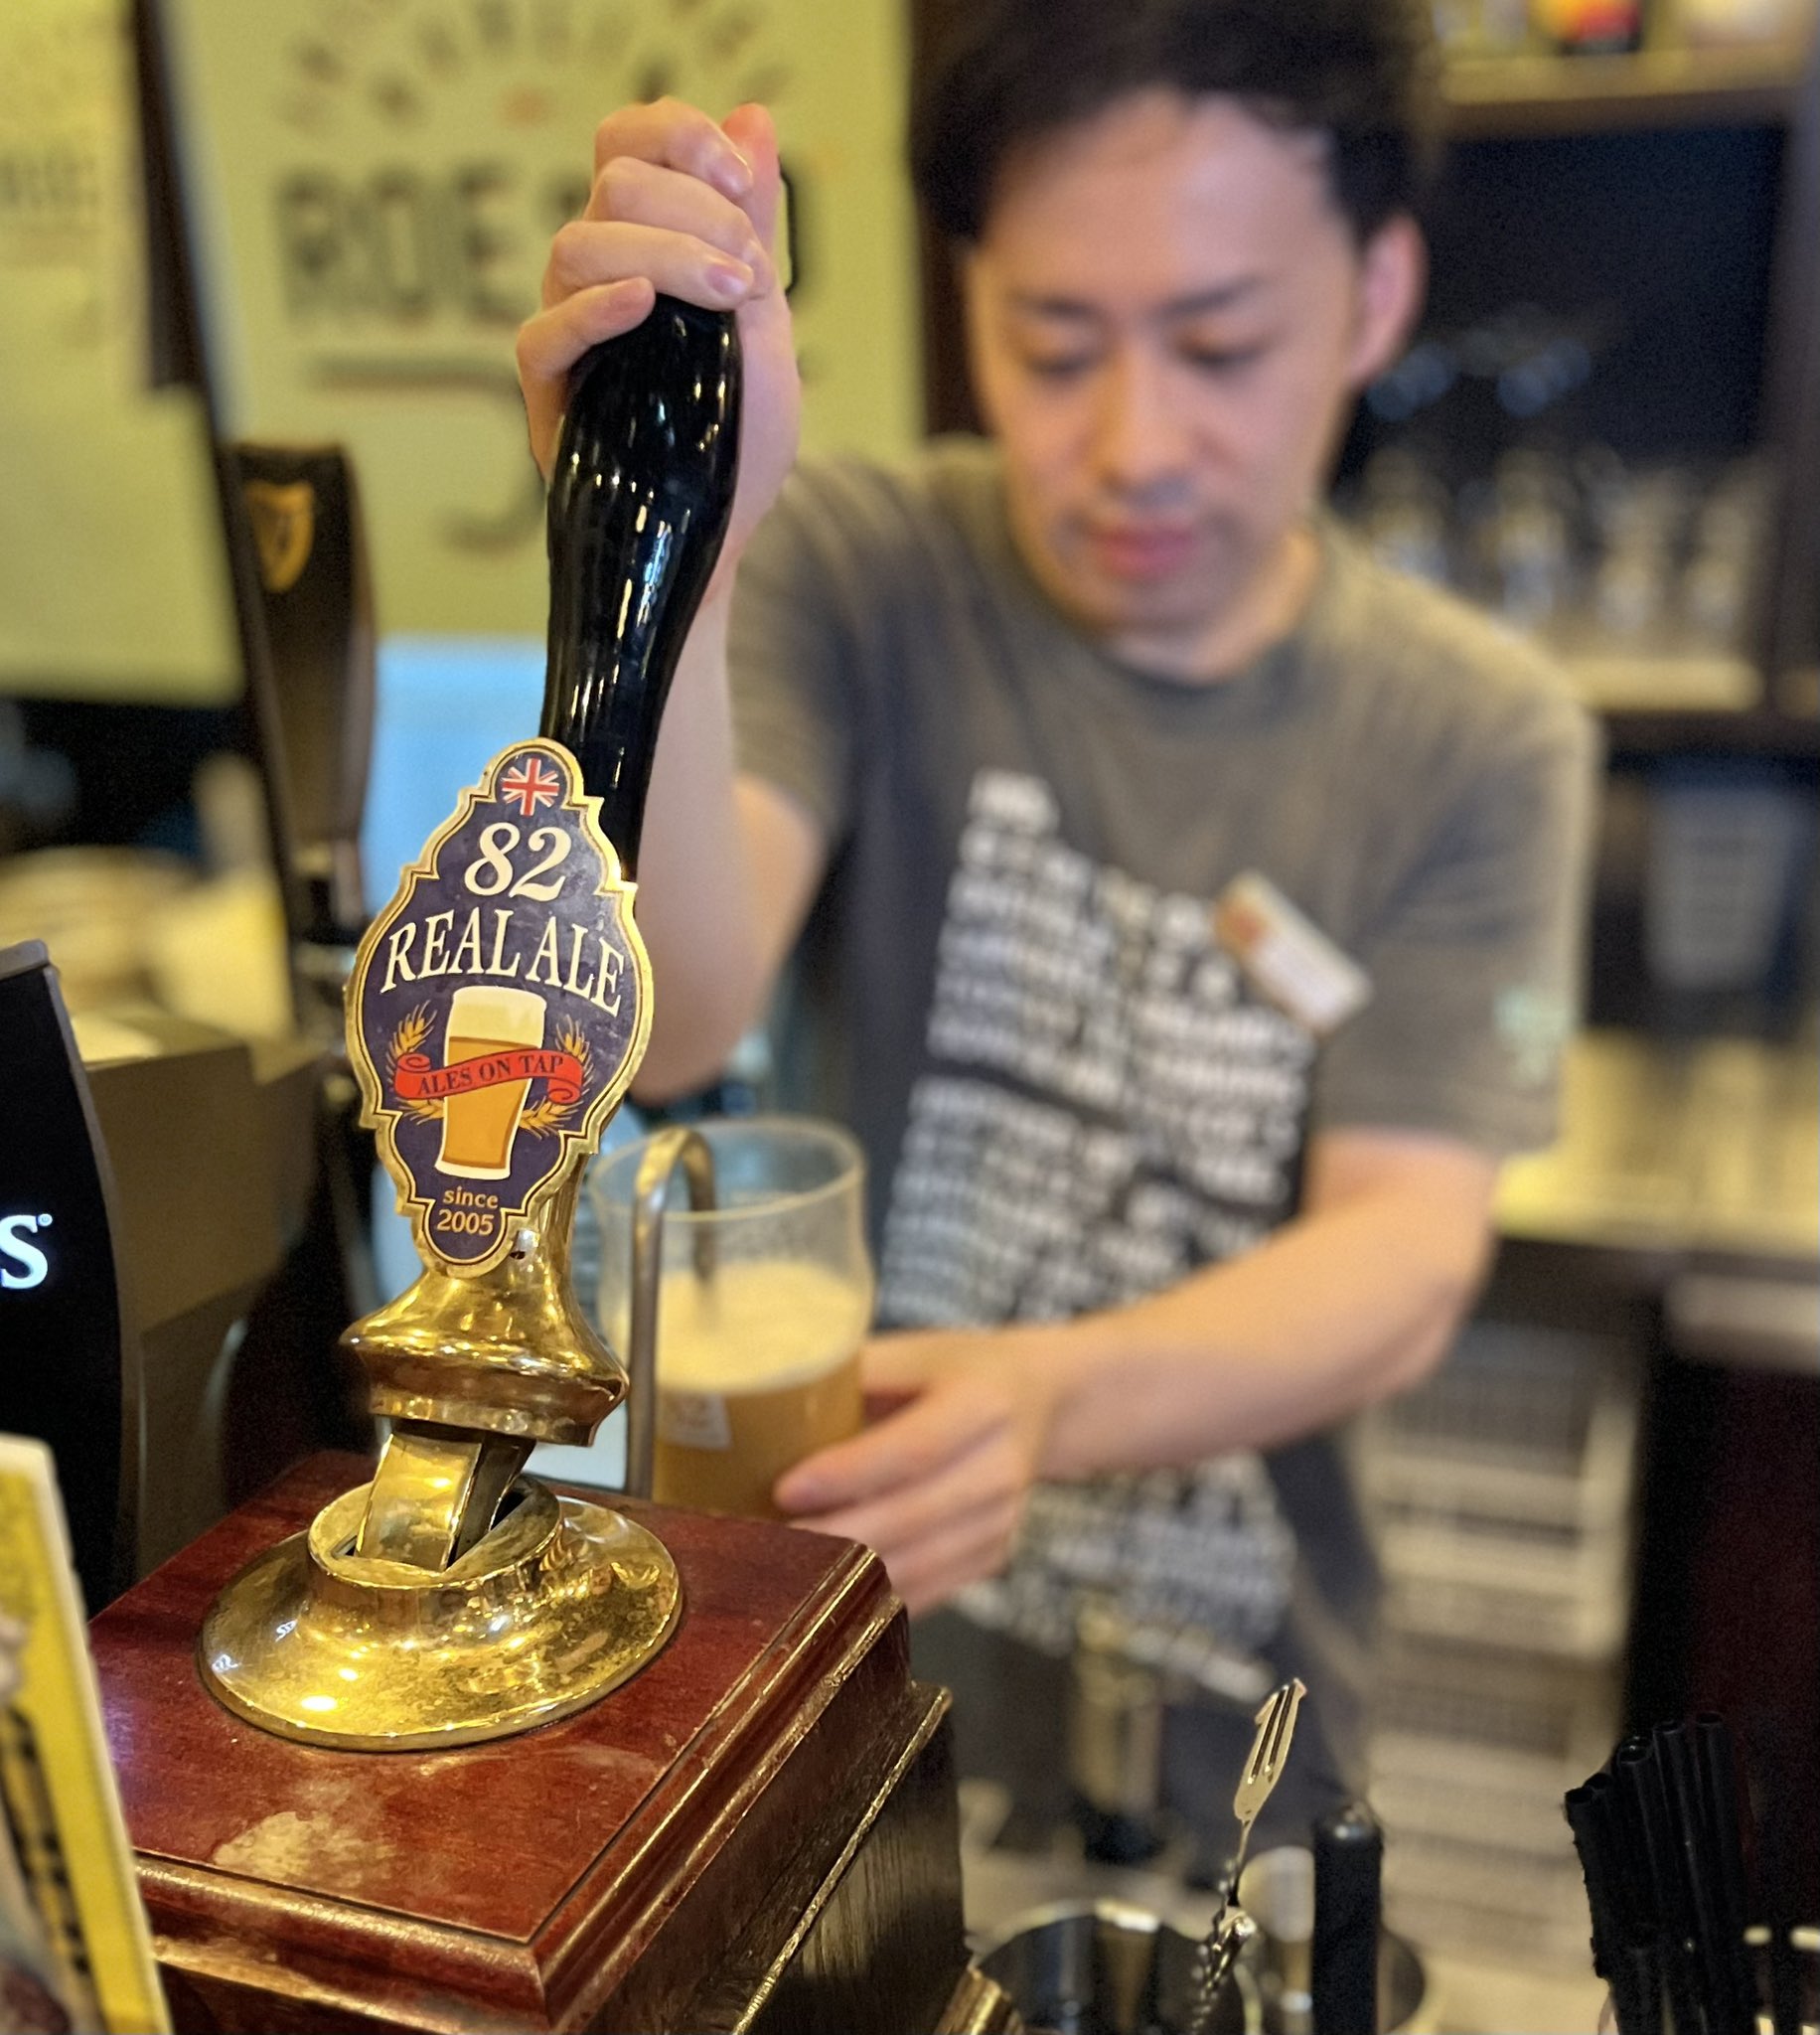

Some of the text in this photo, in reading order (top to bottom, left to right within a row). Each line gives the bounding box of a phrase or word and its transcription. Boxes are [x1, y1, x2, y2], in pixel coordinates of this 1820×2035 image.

[464, 822, 572, 902] 82
[380, 906, 625, 1018] REAL ALE
[417, 1055, 564, 1096] ALES ON TAP
[443, 1185, 499, 1209] since
[436, 1209, 495, 1236] 2005
